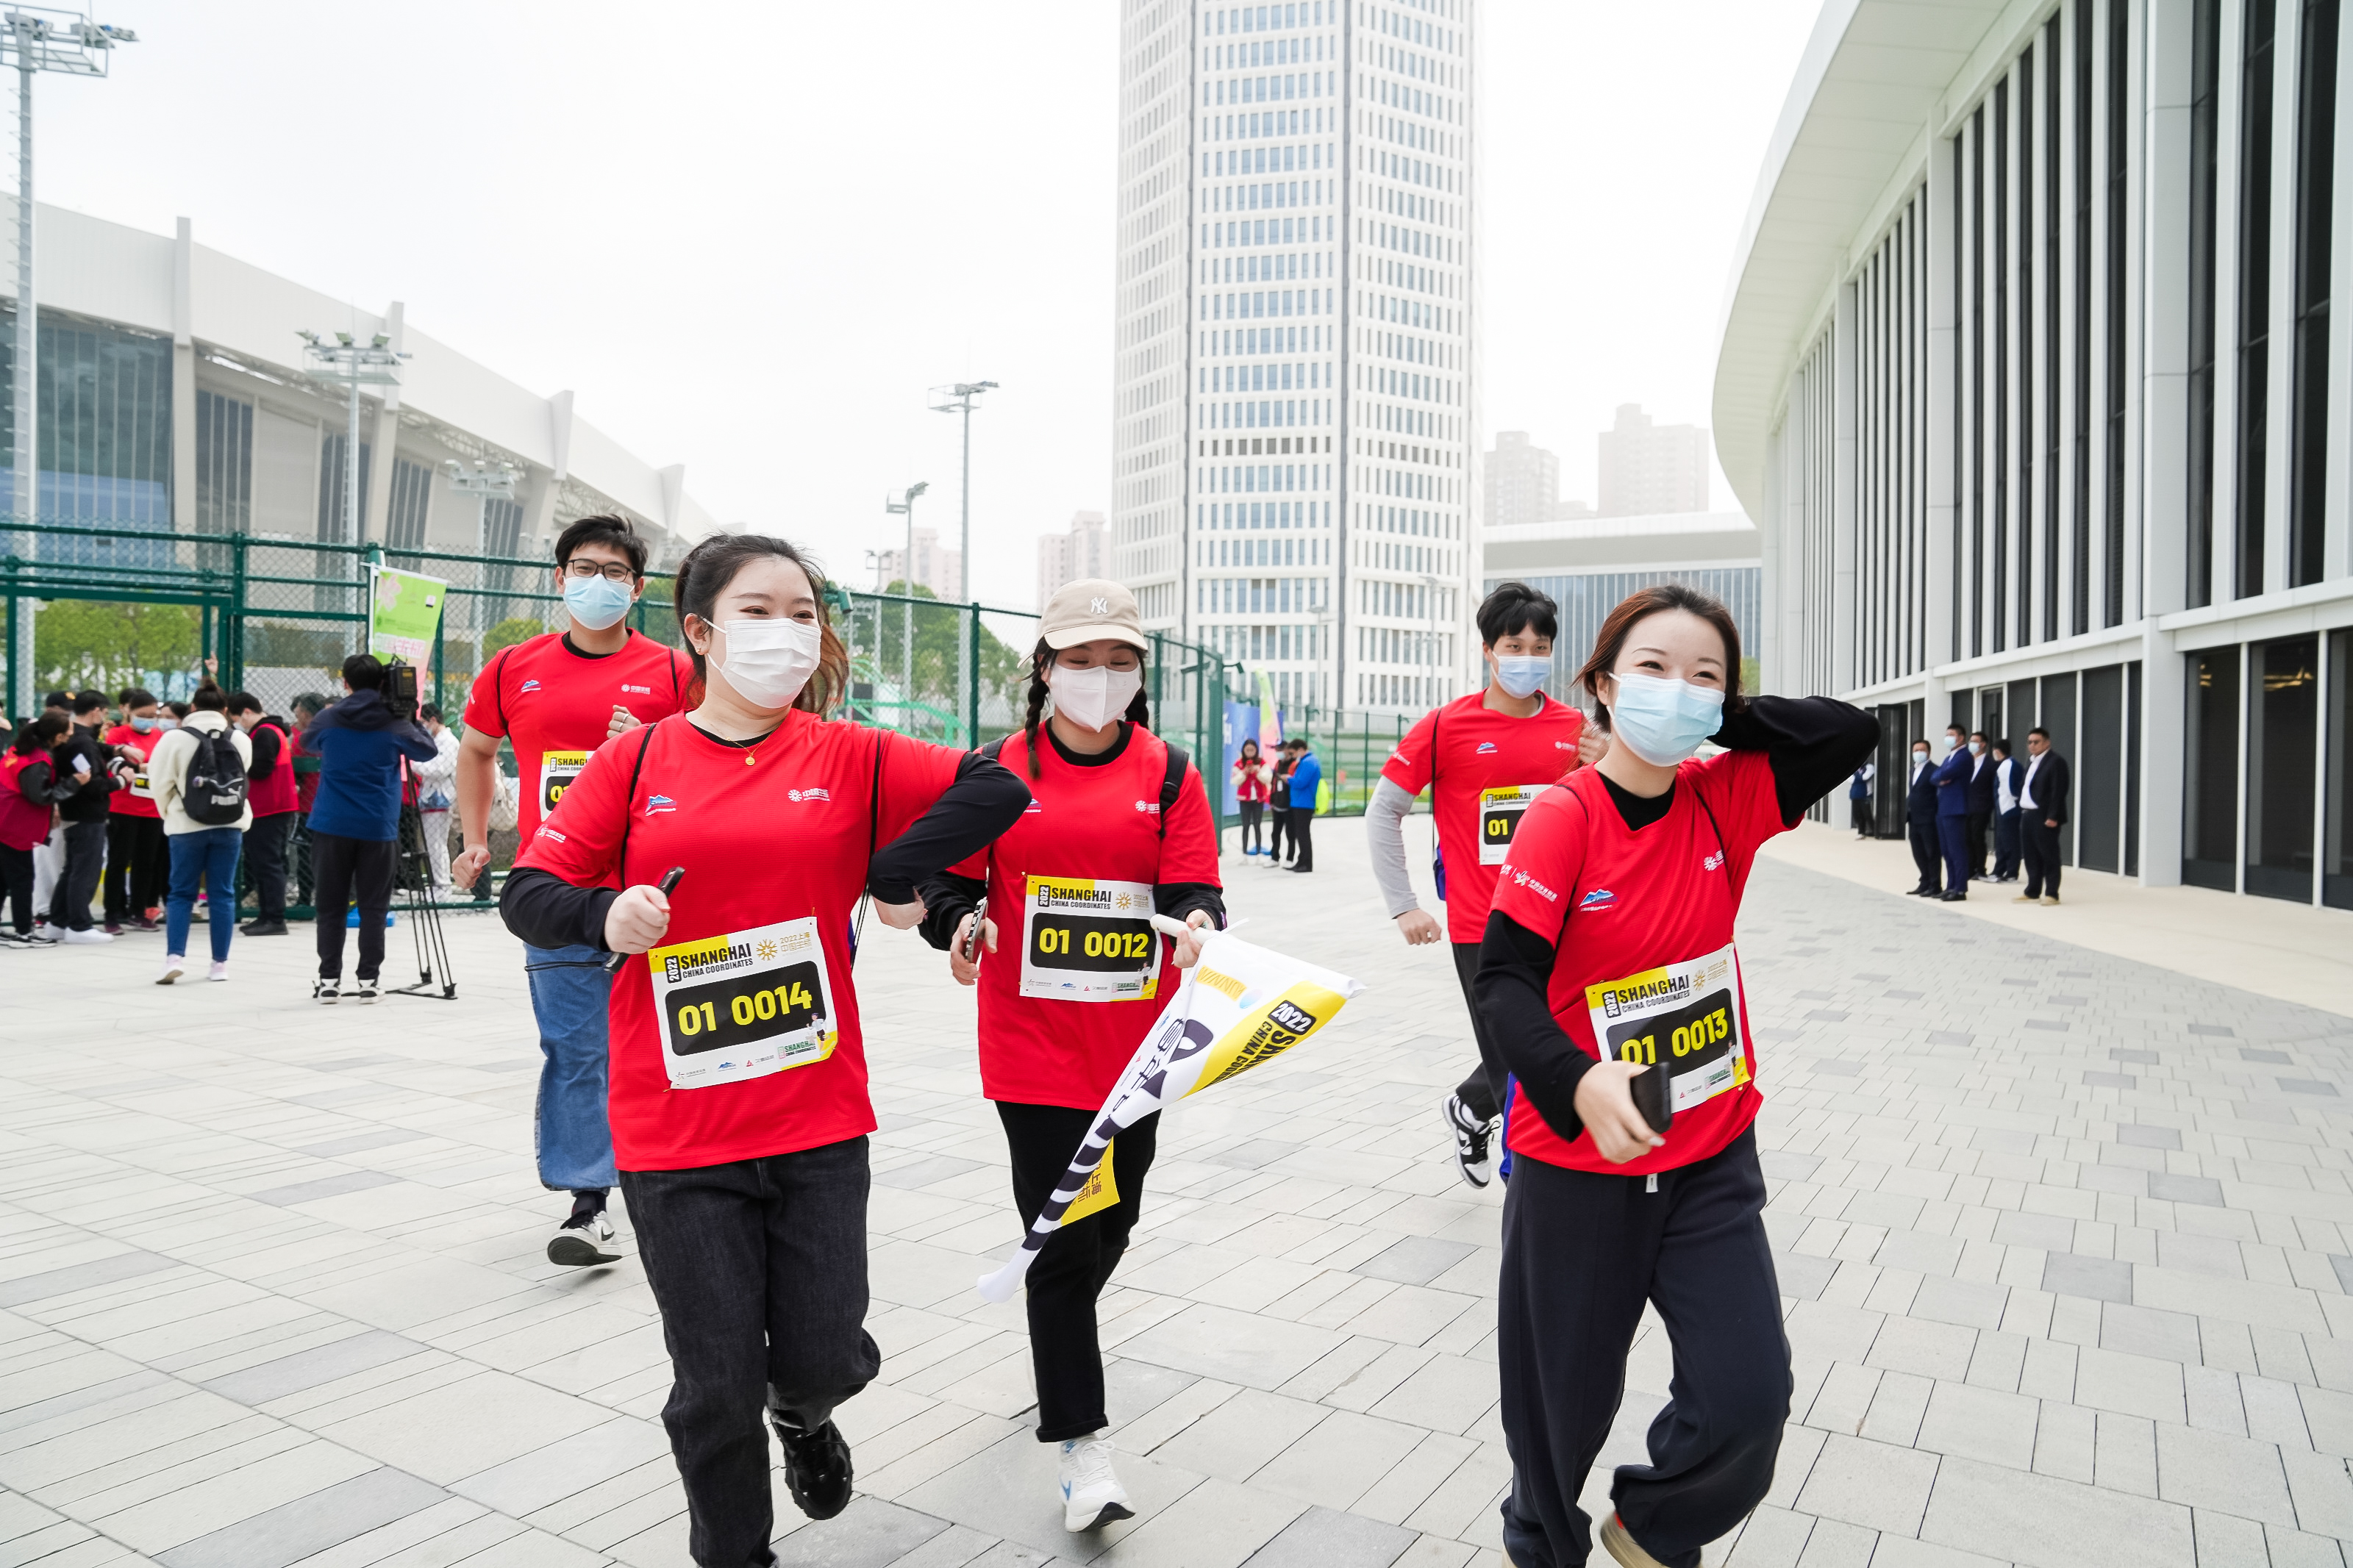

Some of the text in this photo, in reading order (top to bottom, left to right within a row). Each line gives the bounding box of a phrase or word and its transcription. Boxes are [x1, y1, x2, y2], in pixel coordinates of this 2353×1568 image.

[557, 758, 589, 766] SHANG
[1493, 792, 1530, 801] SHANGHAI
[1488, 818, 1508, 836] 01
[1040, 886, 1049, 906] 2022
[1051, 887, 1112, 903] SHANGHAI
[1051, 900, 1111, 910] CHINA COORDINATES
[1039, 928, 1149, 958] 01 0012
[681, 943, 751, 970] SHANGHAI
[682, 958, 754, 978] CHINA COORDINATES
[667, 957, 680, 981] 2022
[1618, 975, 1690, 1004] SHANGHAI
[678, 981, 813, 1036] 01 0014
[1604, 992, 1620, 1017] 2022
[1622, 1001, 1644, 1012] CHINA
[1270, 1003, 1312, 1032] 2022
[1242, 1020, 1273, 1056] CHINA
[1621, 1007, 1728, 1065] 01 0013
